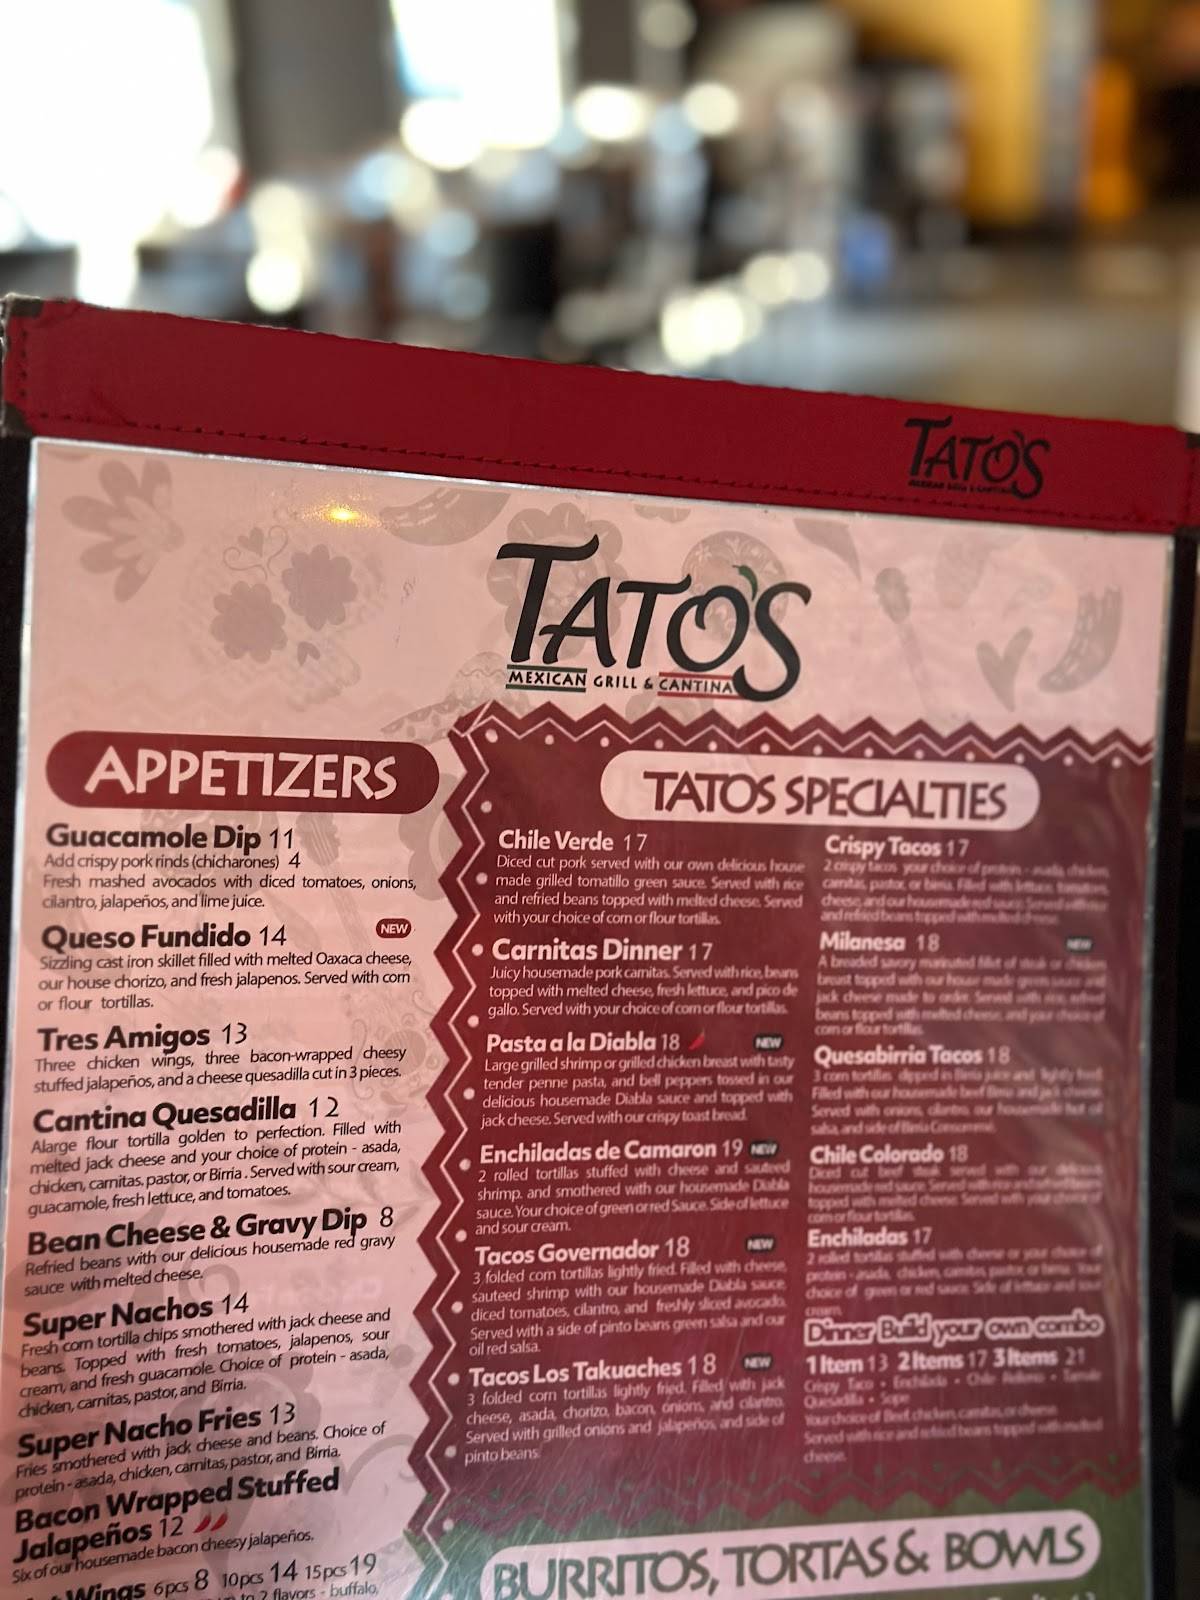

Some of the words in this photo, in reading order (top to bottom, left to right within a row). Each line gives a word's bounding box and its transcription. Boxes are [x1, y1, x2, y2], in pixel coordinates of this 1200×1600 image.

[509, 670, 586, 686] MEXICAN
[594, 676, 637, 689] GRILL
[644, 679, 652, 689] &
[659, 678, 733, 694] CANTINA
[84, 745, 398, 801] APPETIZERS
[643, 770, 776, 815] TATOS
[786, 772, 1006, 820] SPECIALTIES
[46, 823, 207, 849] Guacamole
[214, 825, 261, 854] Dip
[270, 828, 294, 849] 11
[498, 829, 550, 849] Chile
[555, 831, 613, 851] Verde
[623, 834, 647, 851] 17
[825, 835, 885, 859] Crispy
[888, 837, 942, 856] Tacos
[947, 839, 969, 856] 17
[44, 854, 75, 868] Add
[77, 855, 119, 871] crispy
[120, 854, 153, 869] pork
[155, 854, 189, 868] rinds
[191, 855, 279, 871] (chicharones)
[288, 852, 300, 868] 4
[497, 855, 531, 868] Diced
[536, 856, 555, 868] cut
[560, 855, 586, 870] pork
[591, 857, 630, 869] served
[634, 858, 659, 870] with
[664, 861, 683, 871] our
[688, 861, 713, 871] own
[718, 859, 766, 872] delicious
[770, 860, 805, 873] house
[43, 875, 80, 888] Fresh
[89, 875, 144, 888] mashed
[152, 875, 216, 888] avocados
[224, 875, 252, 888] with
[260, 875, 295, 888] diced
[302, 876, 364, 890] tomatoes,
[371, 876, 417, 891] onions,
[42, 895, 97, 910] cilantro,
[99, 895, 168, 911] jalapeños,
[172, 895, 198, 909] and
[201, 894, 229, 908] lime
[231, 895, 265, 910] juice.
[41, 925, 134, 950] Queso
[142, 923, 250, 948] Fundido
[259, 925, 286, 946] 14
[381, 923, 408, 934] NEW
[492, 938, 597, 960] Carnitas
[603, 938, 682, 960] Dinner
[688, 943, 712, 959] 17
[820, 931, 906, 951] Milanesa
[917, 934, 939, 951] 18
[1066, 939, 1091, 949] NEW
[38, 1027, 98, 1051] Tres
[104, 1023, 210, 1052] Amigos
[222, 1022, 248, 1044] 13
[487, 1034, 547, 1053] Pasta
[550, 1039, 564, 1052] a
[567, 1033, 585, 1052] la
[590, 1031, 656, 1051] Diabla
[660, 1034, 680, 1051] 18
[756, 1038, 781, 1049] NEW
[814, 1045, 926, 1067] Quesabirria
[930, 1045, 982, 1064] Tacos
[988, 1047, 1009, 1063] 18
[33, 1107, 146, 1132] Cantina
[152, 1097, 296, 1128] Quesadilla
[480, 1142, 591, 1164] Enchiladas
[595, 1141, 620, 1160] de
[624, 1140, 716, 1159] Camaron
[722, 1139, 743, 1157] 19
[752, 1144, 777, 1155] NEW
[810, 1145, 857, 1164] Chile
[860, 1143, 944, 1163] Colorado
[950, 1145, 968, 1162] 18
[28, 1230, 100, 1255] Bean
[105, 1217, 205, 1248] Cheese
[210, 1216, 230, 1238] &
[236, 1212, 316, 1239] Gravy
[322, 1207, 367, 1237] Dip
[380, 1207, 393, 1227] 8
[808, 1227, 908, 1247] Enchiladas
[913, 1227, 931, 1244] 17
[26, 1260, 74, 1276] Refried
[80, 1256, 121, 1270] beans
[127, 1253, 156, 1266] with
[162, 1251, 186, 1263] our
[190, 1244, 247, 1260] delicious
[252, 1239, 329, 1255] housemade
[334, 1235, 354, 1249] red
[360, 1235, 395, 1251] gravy
[475, 1246, 534, 1265] Tacos
[538, 1239, 659, 1262] Governador
[664, 1237, 689, 1257] 18
[748, 1239, 773, 1249] NEW
[24, 1282, 64, 1296] sauce
[70, 1277, 100, 1293] with
[103, 1273, 151, 1288] melted
[154, 1268, 204, 1283] cheese.
[23, 1310, 106, 1340] Super
[111, 1297, 213, 1326] Nachos
[223, 1292, 249, 1314] 14
[805, 1318, 875, 1346] Dinner
[878, 1314, 931, 1344] Build
[933, 1318, 983, 1347] your
[986, 1316, 1032, 1339] own
[1035, 1309, 1103, 1337] combo
[469, 1368, 529, 1387] Tacos
[534, 1365, 569, 1383] Los
[573, 1357, 681, 1381] Takuaches
[745, 1357, 771, 1368] NEW
[869, 1355, 888, 1372] 13
[968, 1351, 986, 1368] 17
[1065, 1348, 1085, 1365] 21
[17, 1432, 99, 1460] Super
[104, 1415, 192, 1445] Nacho
[199, 1406, 261, 1433] Fries
[270, 1402, 295, 1424] 13
[15, 1501, 100, 1533] Bacon
[106, 1480, 233, 1517] Wrapped
[238, 1467, 340, 1499] Stuffed
[13, 1523, 152, 1565] Jalapeños
[160, 1517, 182, 1537] 12
[13, 1569, 31, 1583] Six
[34, 1566, 47, 1579] of
[50, 1564, 71, 1575] our
[74, 1547, 153, 1572] housemade
[156, 1543, 199, 1557] bacon
[201, 1536, 246, 1550] cheesy
[247, 1530, 314, 1548] jalapeños.
[494, 1548, 719, 1600] BURRITOS,
[722, 1536, 888, 1587] TORTAS
[894, 1528, 929, 1575] &
[945, 1525, 1084, 1572] BOWLS
[65, 1583, 146, 1600] Wings
[195, 1569, 209, 1590] 8
[270, 1560, 298, 1582] 14
[350, 1553, 377, 1575] 19
